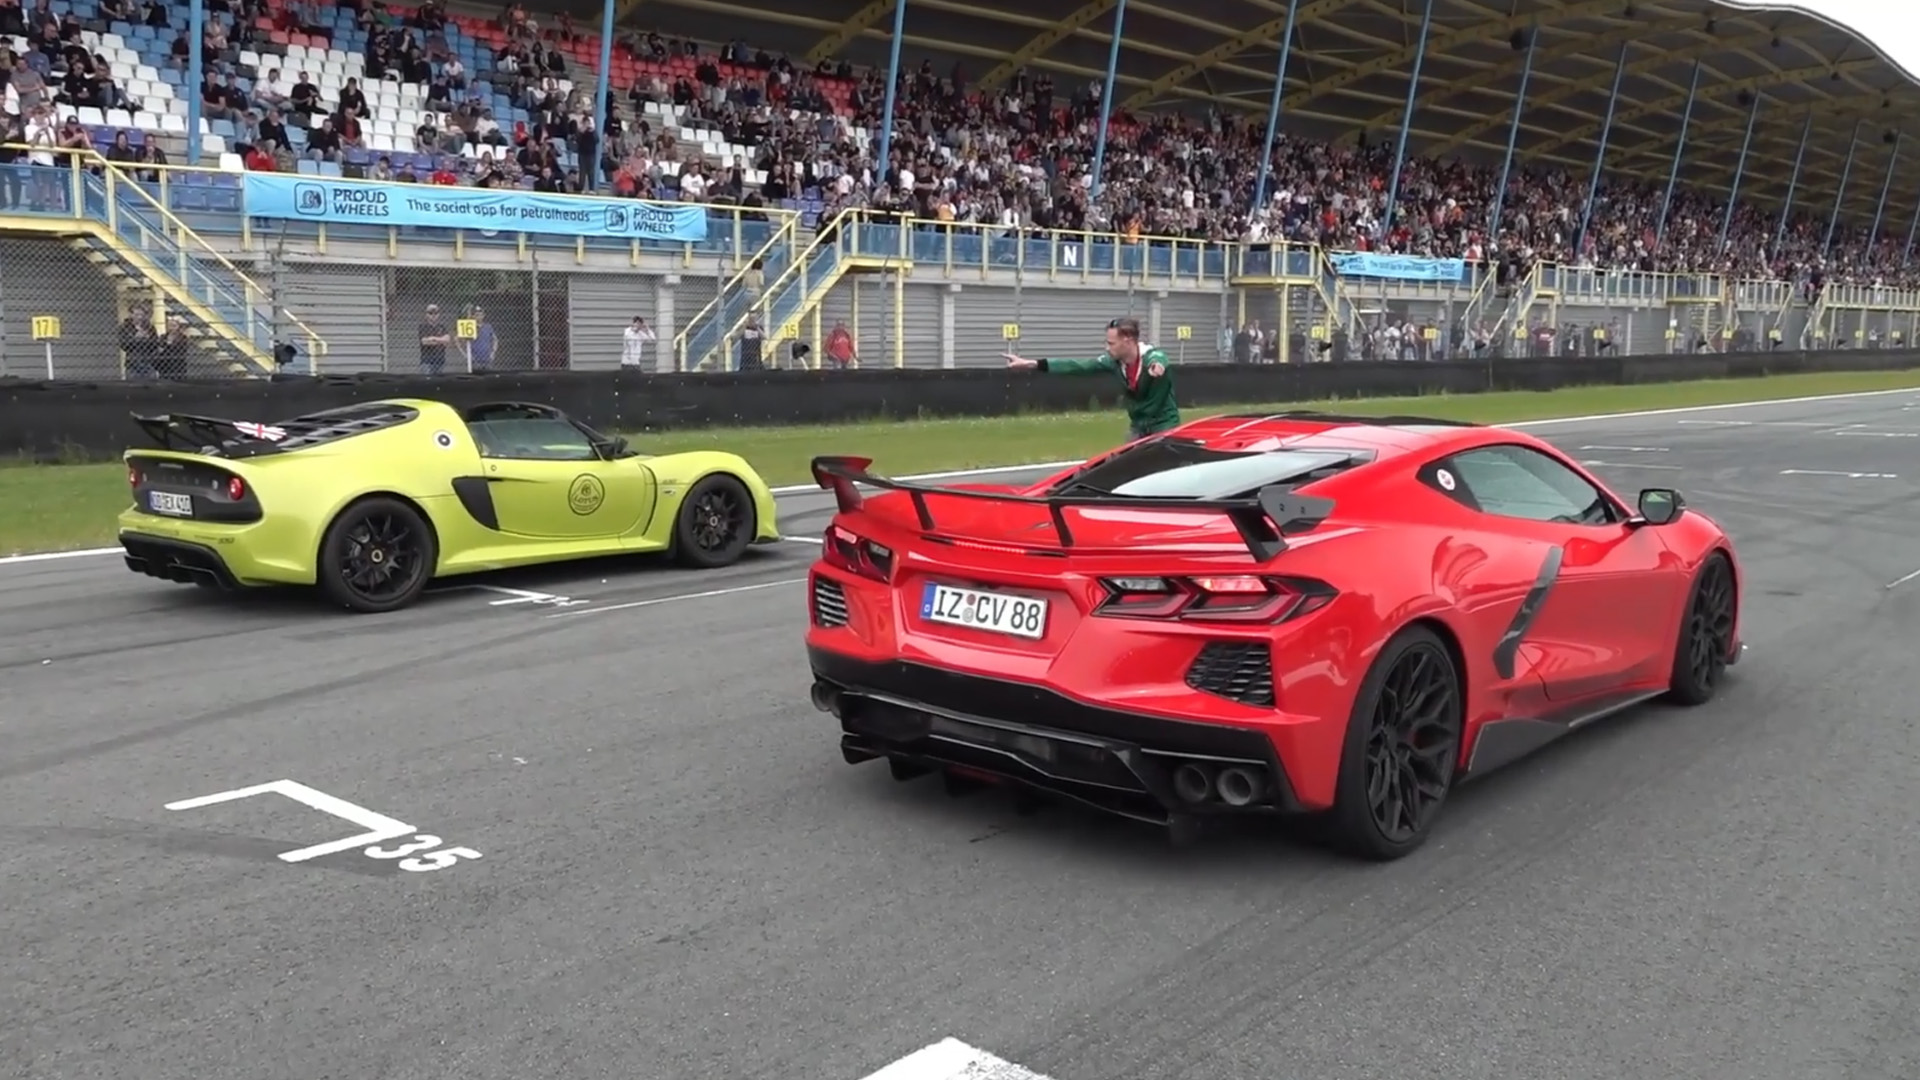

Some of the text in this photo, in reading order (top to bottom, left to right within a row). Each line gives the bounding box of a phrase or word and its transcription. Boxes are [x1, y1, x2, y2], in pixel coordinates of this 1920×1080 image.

[333, 188, 387, 204] PROUD
[333, 202, 389, 217] WHEELS
[406, 199, 590, 222] The social app for petrolheads
[633, 208, 674, 223] PROUD
[633, 221, 675, 234] WHEELS
[1064, 245, 1077, 266] N
[35, 319, 50, 336] 17
[460, 321, 475, 336] 16
[784, 324, 796, 337] 15
[1004, 326, 1017, 337] 14
[934, 590, 1041, 632] IZ CV 88
[364, 834, 483, 872] 35
